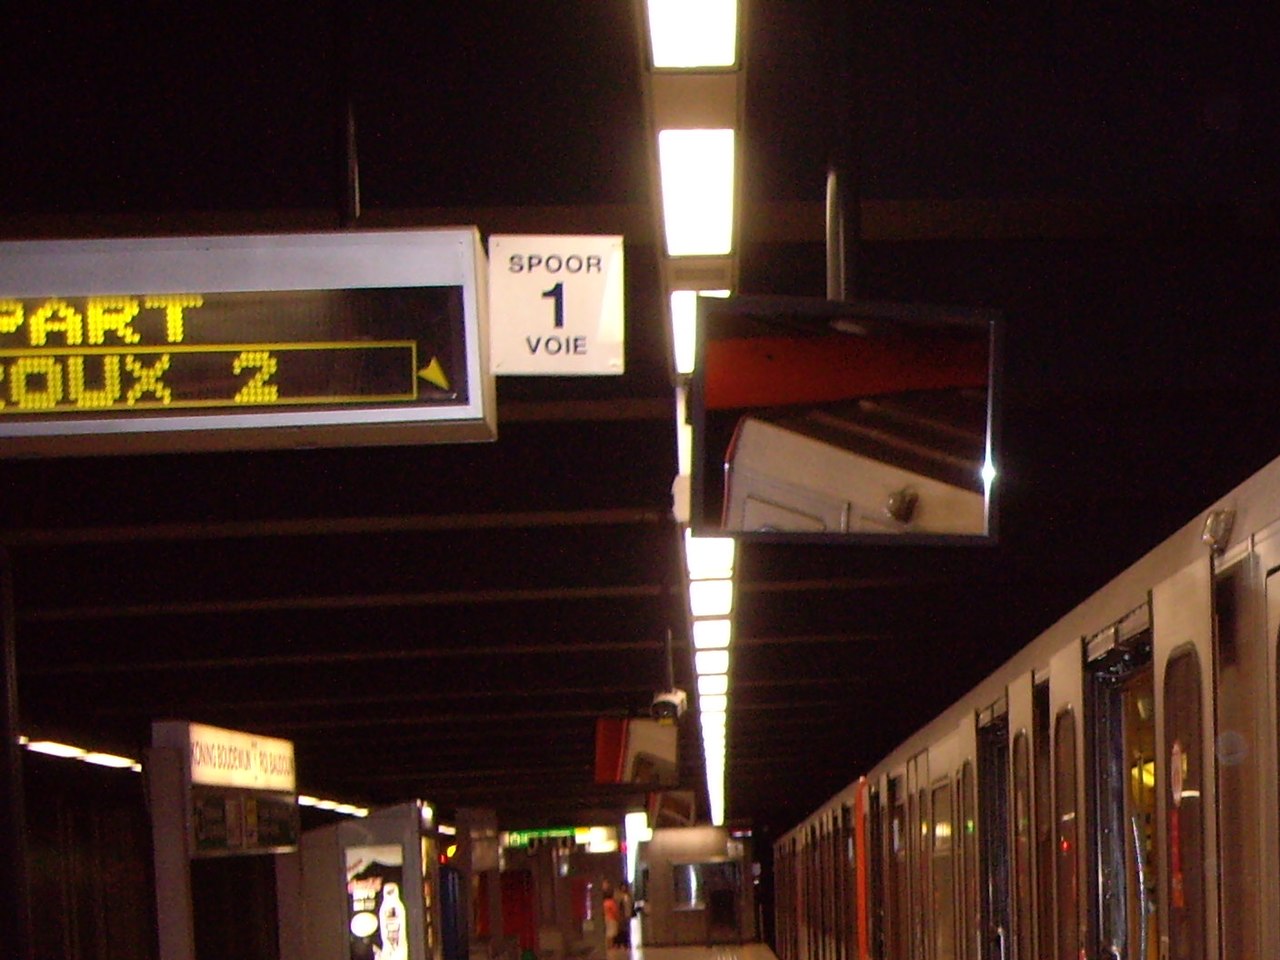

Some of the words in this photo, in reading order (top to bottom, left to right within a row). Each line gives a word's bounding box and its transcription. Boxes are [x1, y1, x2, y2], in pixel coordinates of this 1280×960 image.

[508, 253, 602, 274] SPOOR
[541, 281, 564, 329] 1
[525, 335, 588, 355] VOIE
[0, 352, 172, 409] OUX
[232, 350, 279, 403] 2
